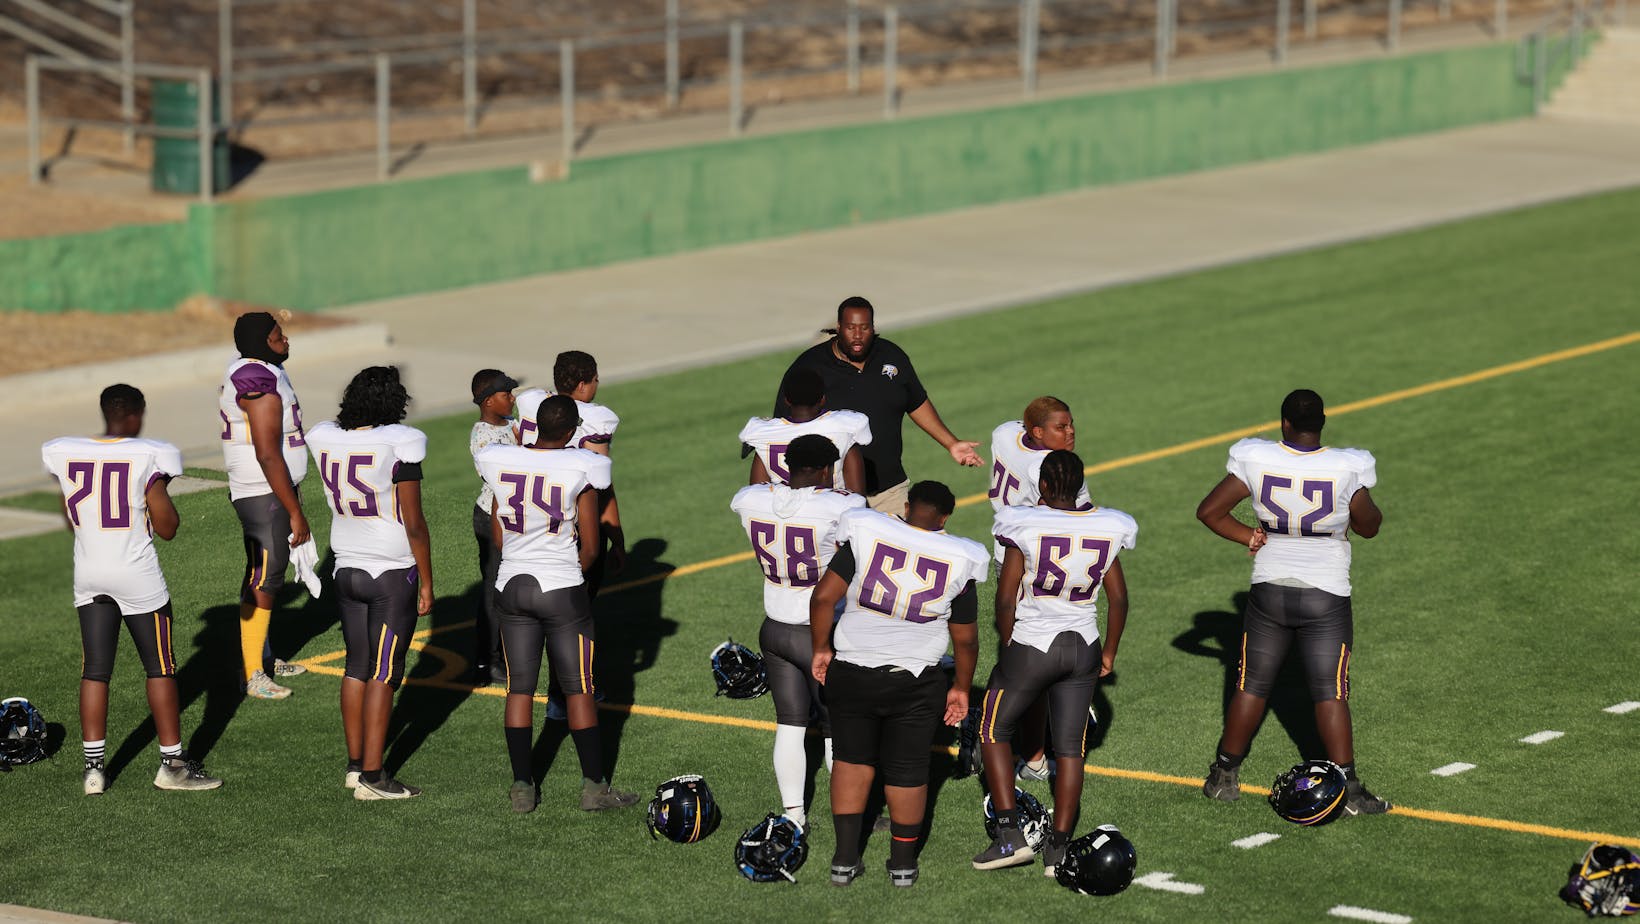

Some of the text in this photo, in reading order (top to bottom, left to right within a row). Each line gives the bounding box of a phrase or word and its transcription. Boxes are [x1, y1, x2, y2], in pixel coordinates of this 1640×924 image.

[66, 460, 133, 531] 70
[320, 450, 381, 520] 45
[498, 471, 566, 536] 34
[1258, 471, 1336, 538] 52
[748, 518, 821, 589] 68
[857, 538, 953, 624] 62
[1031, 534, 1113, 605] 63
